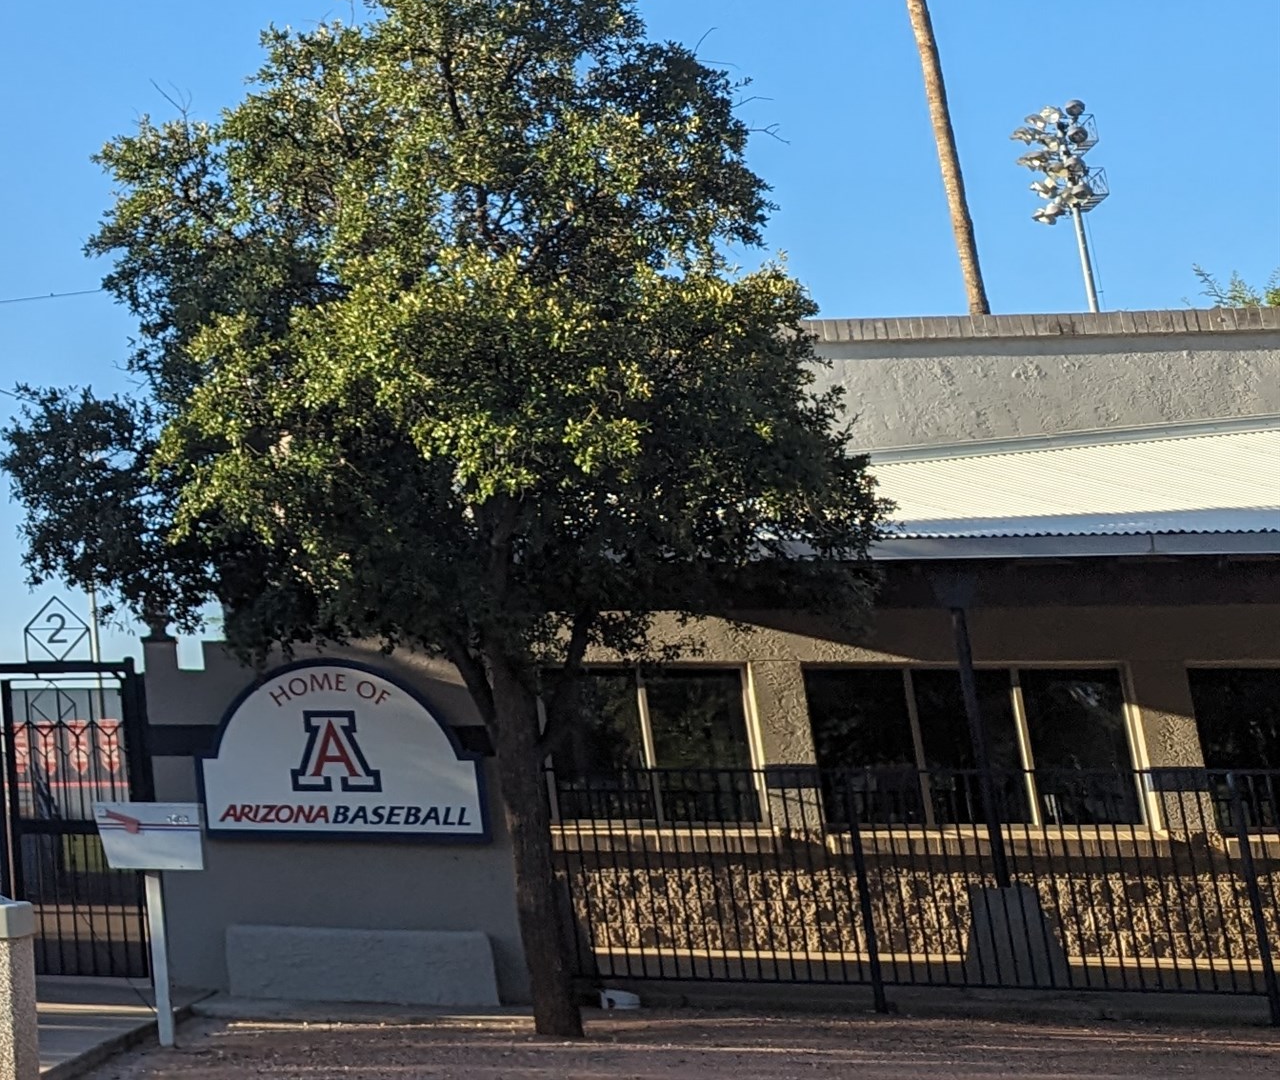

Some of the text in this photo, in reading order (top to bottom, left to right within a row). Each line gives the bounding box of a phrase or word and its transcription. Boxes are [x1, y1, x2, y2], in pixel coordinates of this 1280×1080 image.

[45, 612, 69, 644] 2
[268, 672, 392, 708] HOME OF
[290, 709, 383, 793] A
[219, 803, 472, 827] ARIZONA BASEBALL
